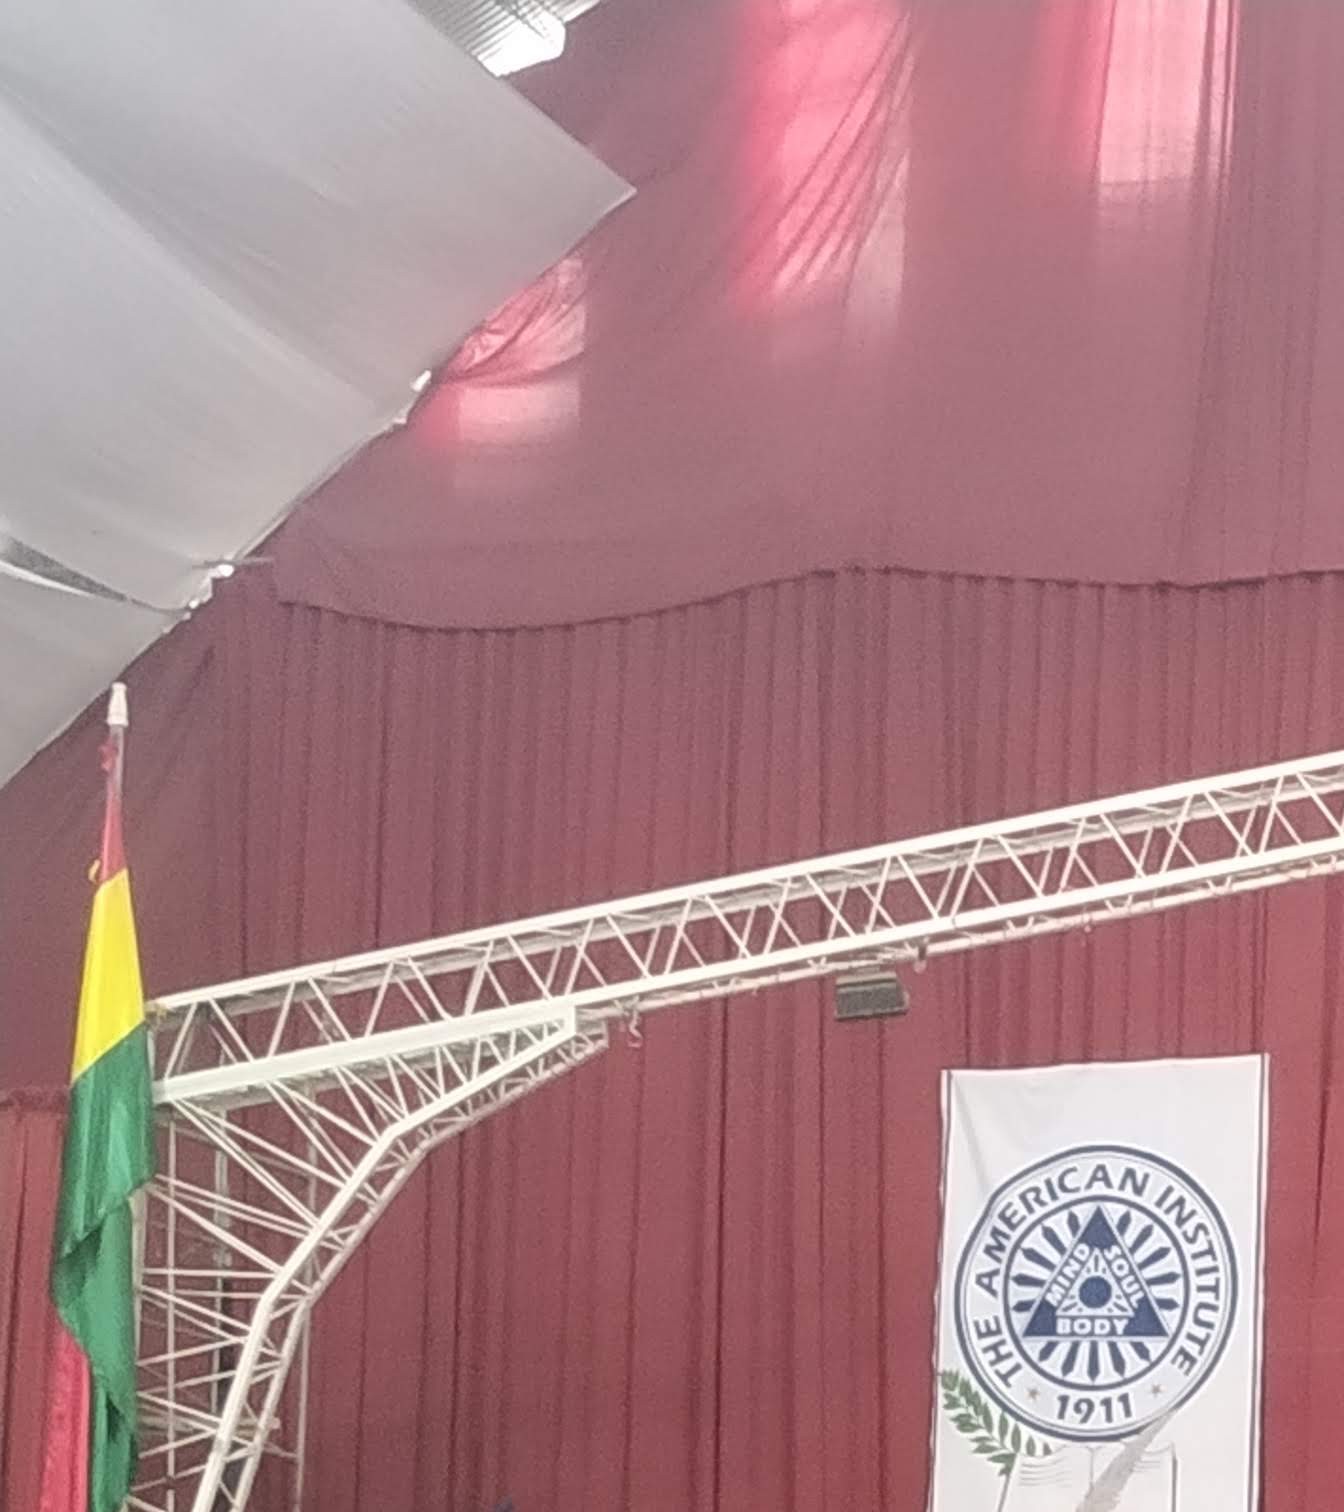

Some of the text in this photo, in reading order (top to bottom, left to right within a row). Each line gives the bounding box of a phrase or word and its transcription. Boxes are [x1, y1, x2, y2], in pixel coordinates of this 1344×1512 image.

[974, 1162, 1222, 1389] THE AMERICAN INSTITUTE
[1045, 1243, 1090, 1308] MIND
[1103, 1244, 1148, 1311] SOUL
[1055, 1317, 1130, 1336] BODY
[1056, 1391, 1133, 1425] 1911
